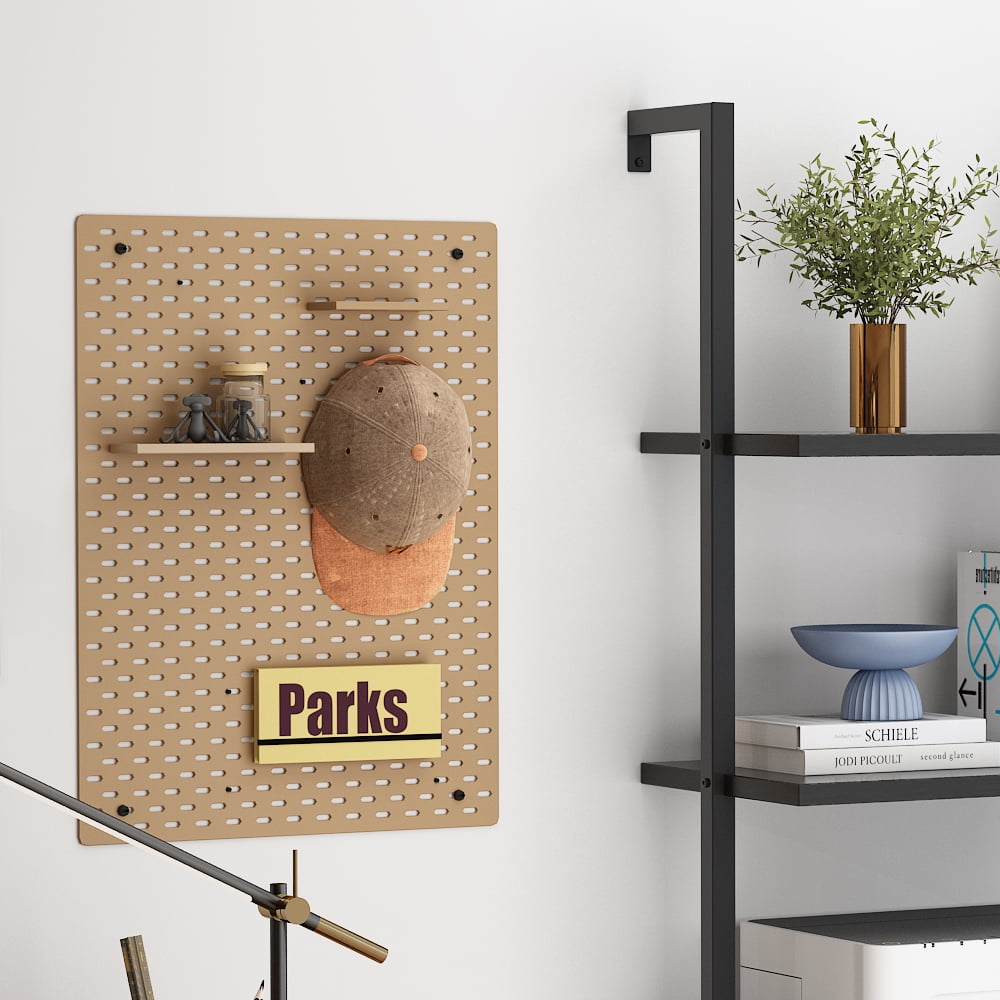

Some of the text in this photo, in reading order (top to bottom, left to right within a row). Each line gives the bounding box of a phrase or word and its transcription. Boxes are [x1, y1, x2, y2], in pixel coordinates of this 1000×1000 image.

[279, 681, 408, 736] Parks
[865, 727, 918, 742] SCHIELE
[834, 754, 903, 768] JODI PICOULT
[949, 752, 974, 761] glance
